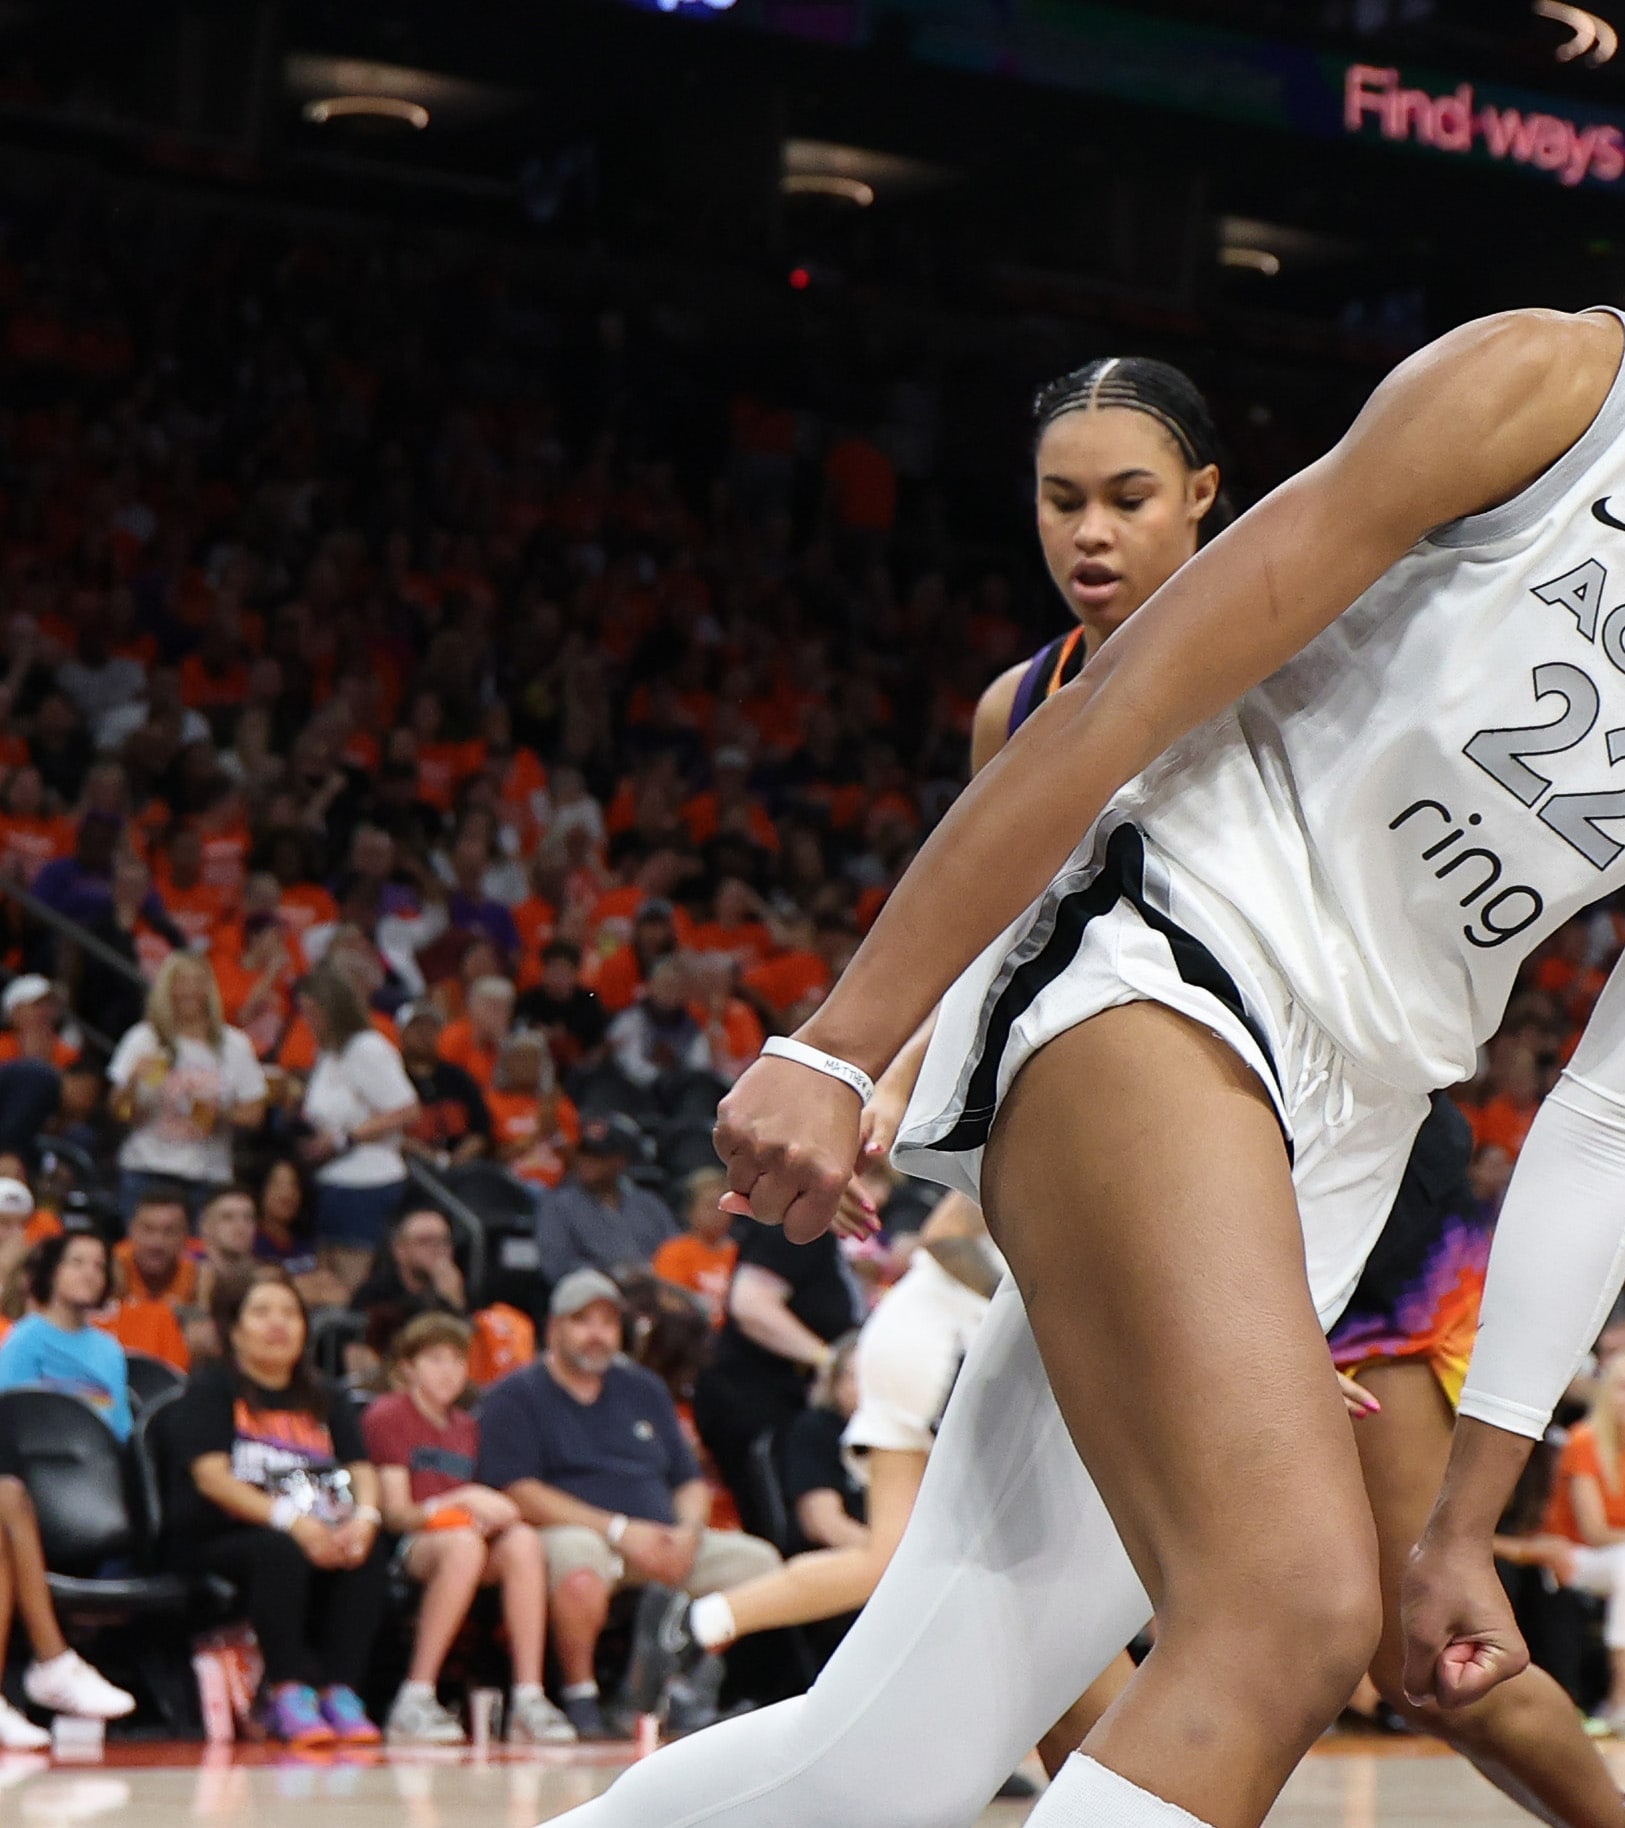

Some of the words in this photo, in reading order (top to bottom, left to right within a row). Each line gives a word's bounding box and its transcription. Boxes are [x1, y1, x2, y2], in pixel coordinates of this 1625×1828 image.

[1344, 63, 1473, 152] Find
[1480, 105, 1625, 187] ways
[1389, 799, 1544, 948] ring
